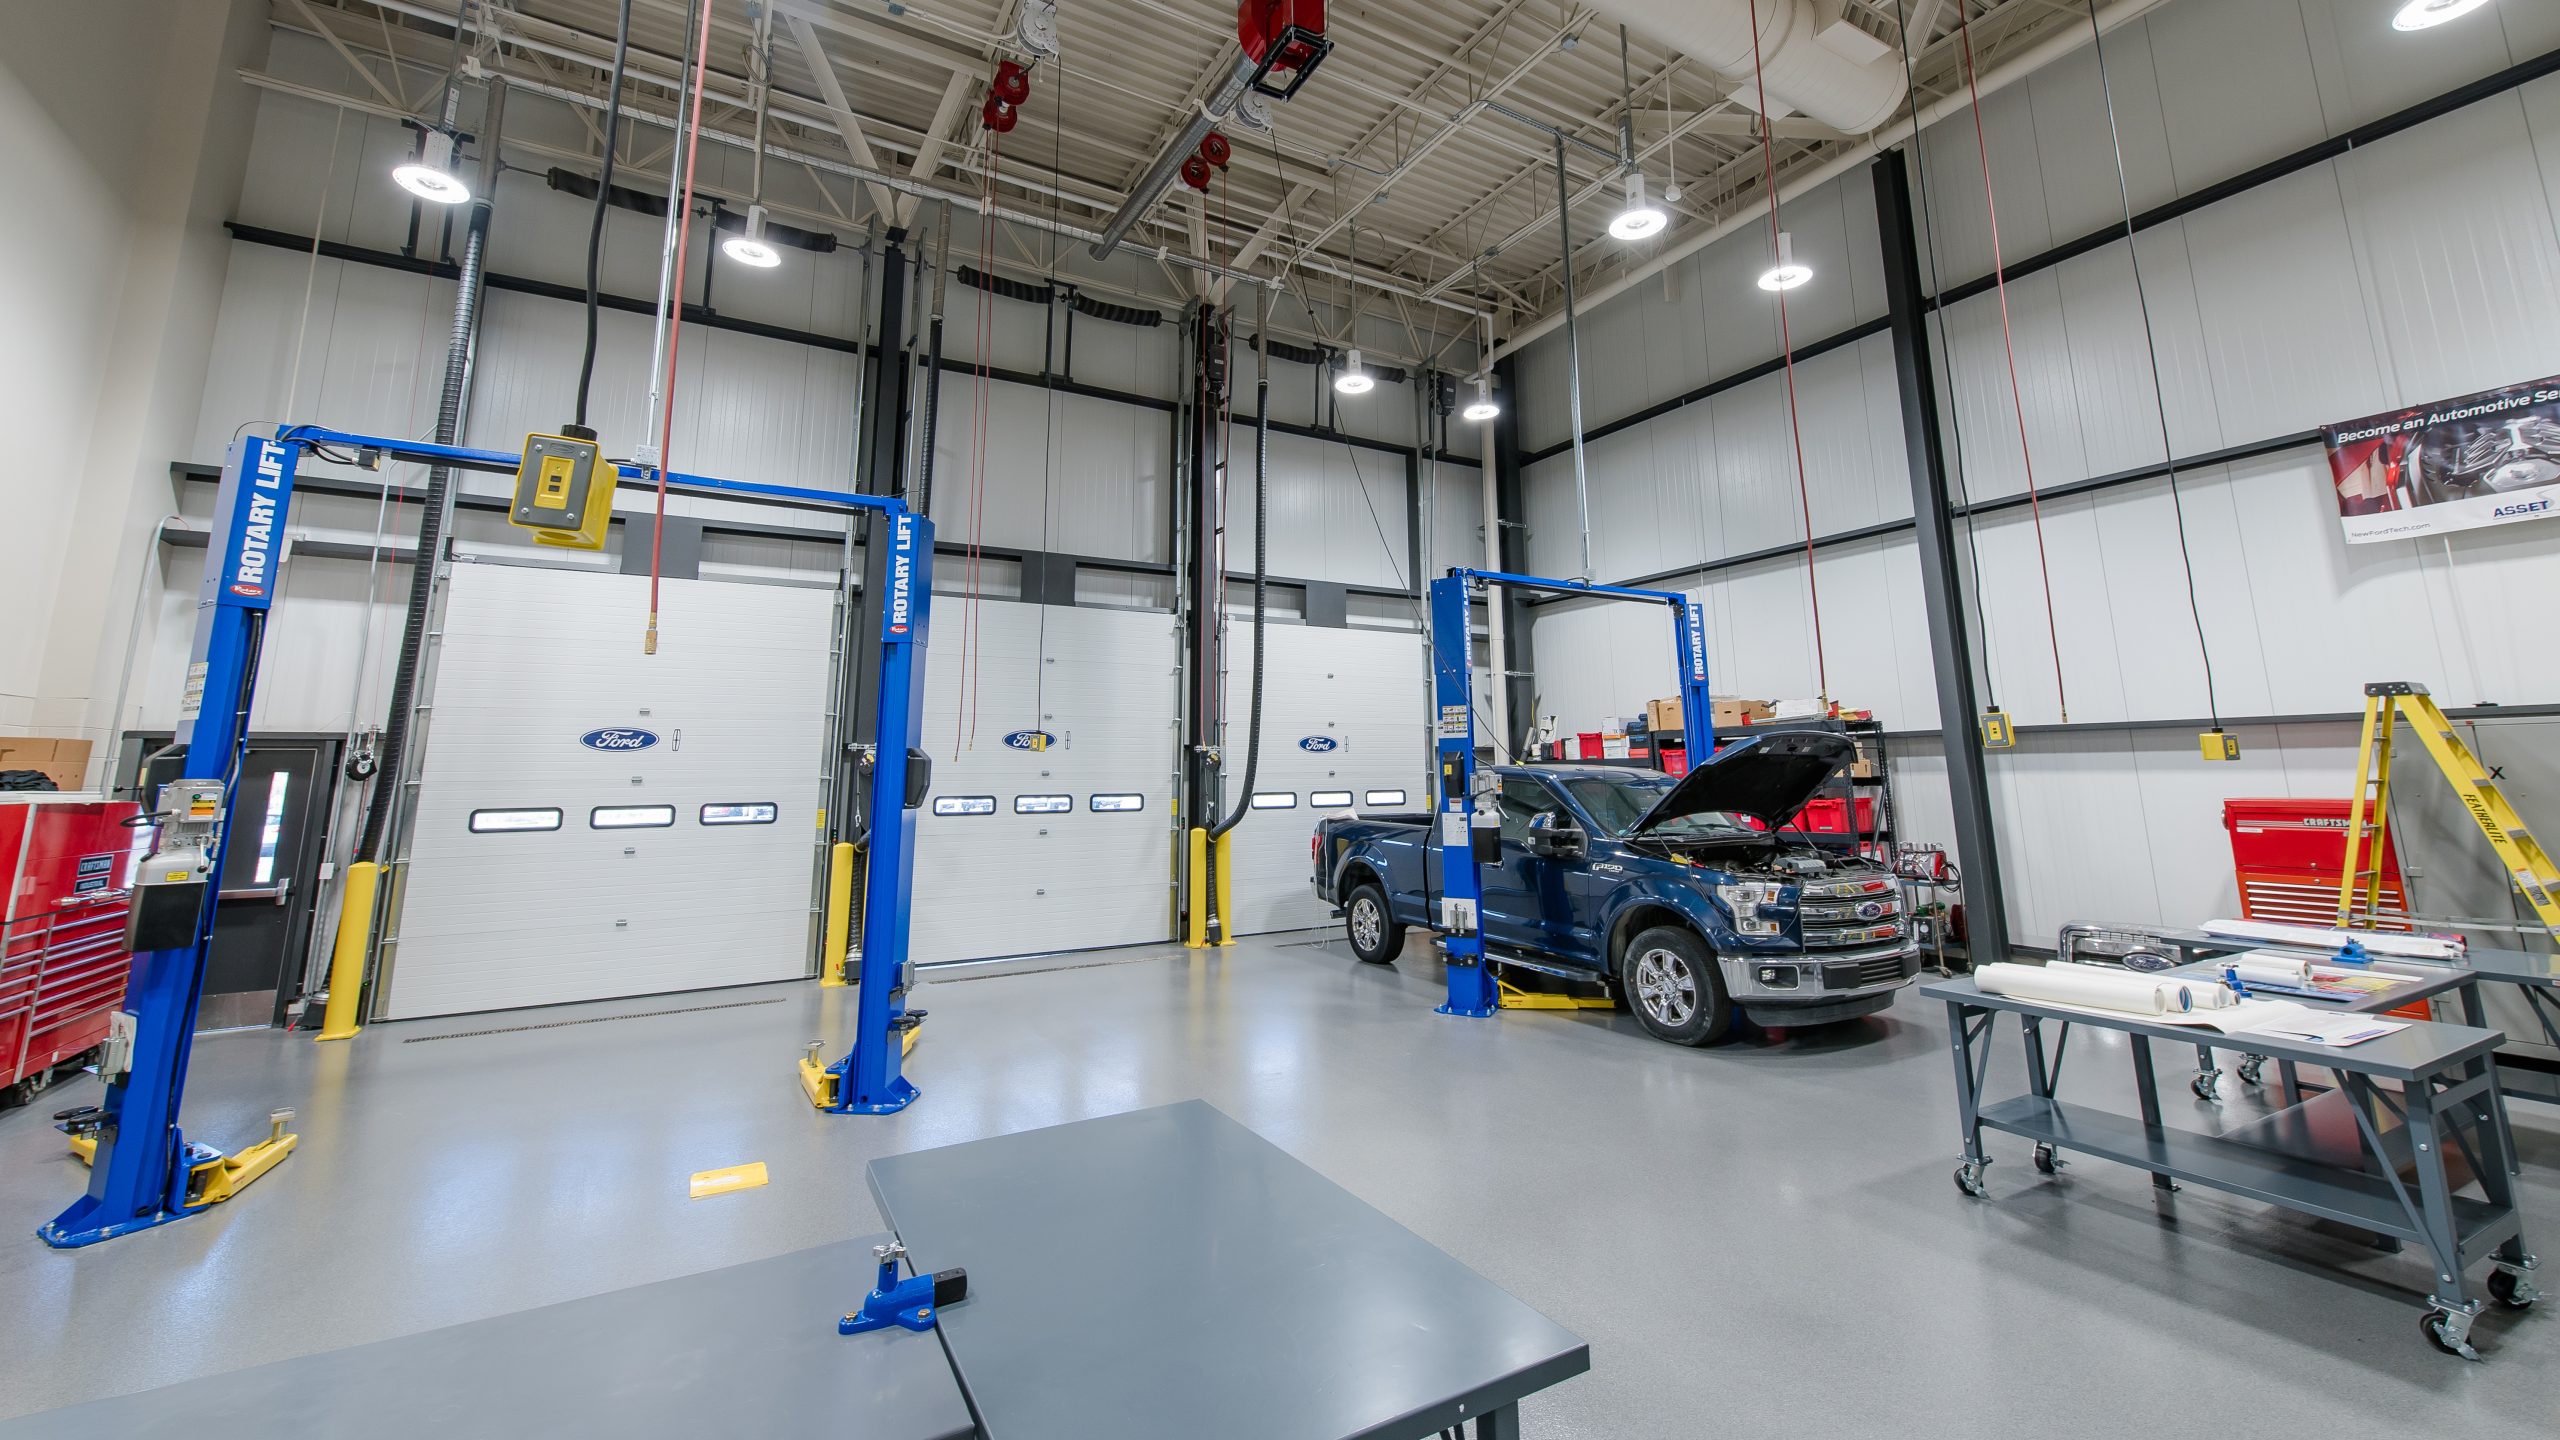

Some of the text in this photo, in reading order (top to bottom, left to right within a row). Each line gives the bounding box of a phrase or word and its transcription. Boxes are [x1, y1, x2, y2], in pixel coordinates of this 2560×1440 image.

[2337, 389, 2560, 444] Become an Automotive Se
[237, 440, 286, 584] ROTARY LIFT
[2493, 500, 2549, 518] ASSET
[2351, 523, 2431, 539] NewFordTech.com
[892, 514, 912, 624] ROTARY LIFT
[1688, 604, 1700, 628] LIFT
[1691, 630, 1704, 675] ROTARY
[596, 730, 645, 748] Ford
[2303, 818, 2368, 829] CRAFTSMN
[2463, 793, 2508, 844] FEATHERLITE
